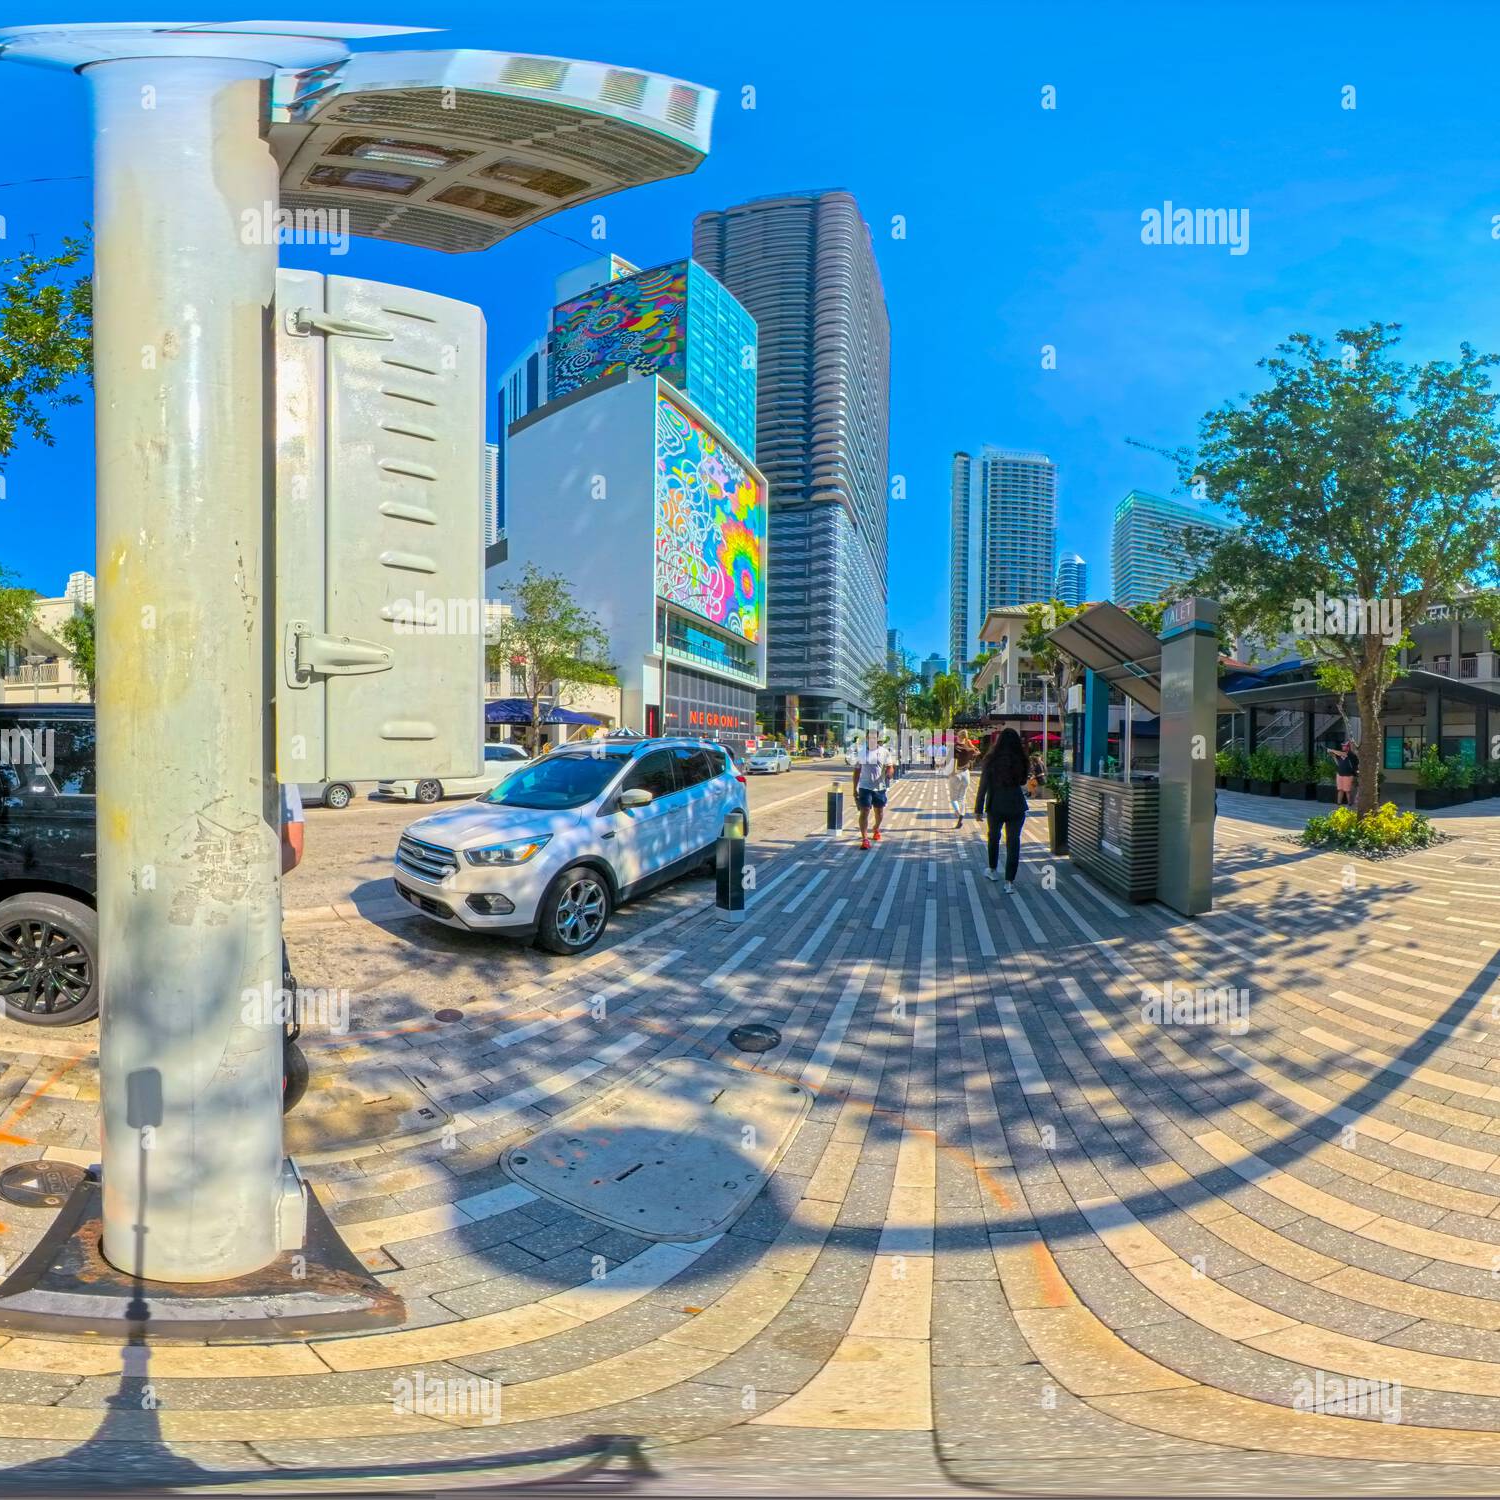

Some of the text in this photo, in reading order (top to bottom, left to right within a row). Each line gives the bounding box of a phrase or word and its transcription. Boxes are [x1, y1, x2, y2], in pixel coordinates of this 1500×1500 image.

[1163, 601, 1192, 625] VALET
[1012, 703, 1057, 715] NORT
[689, 710, 739, 728] NEGRONI
